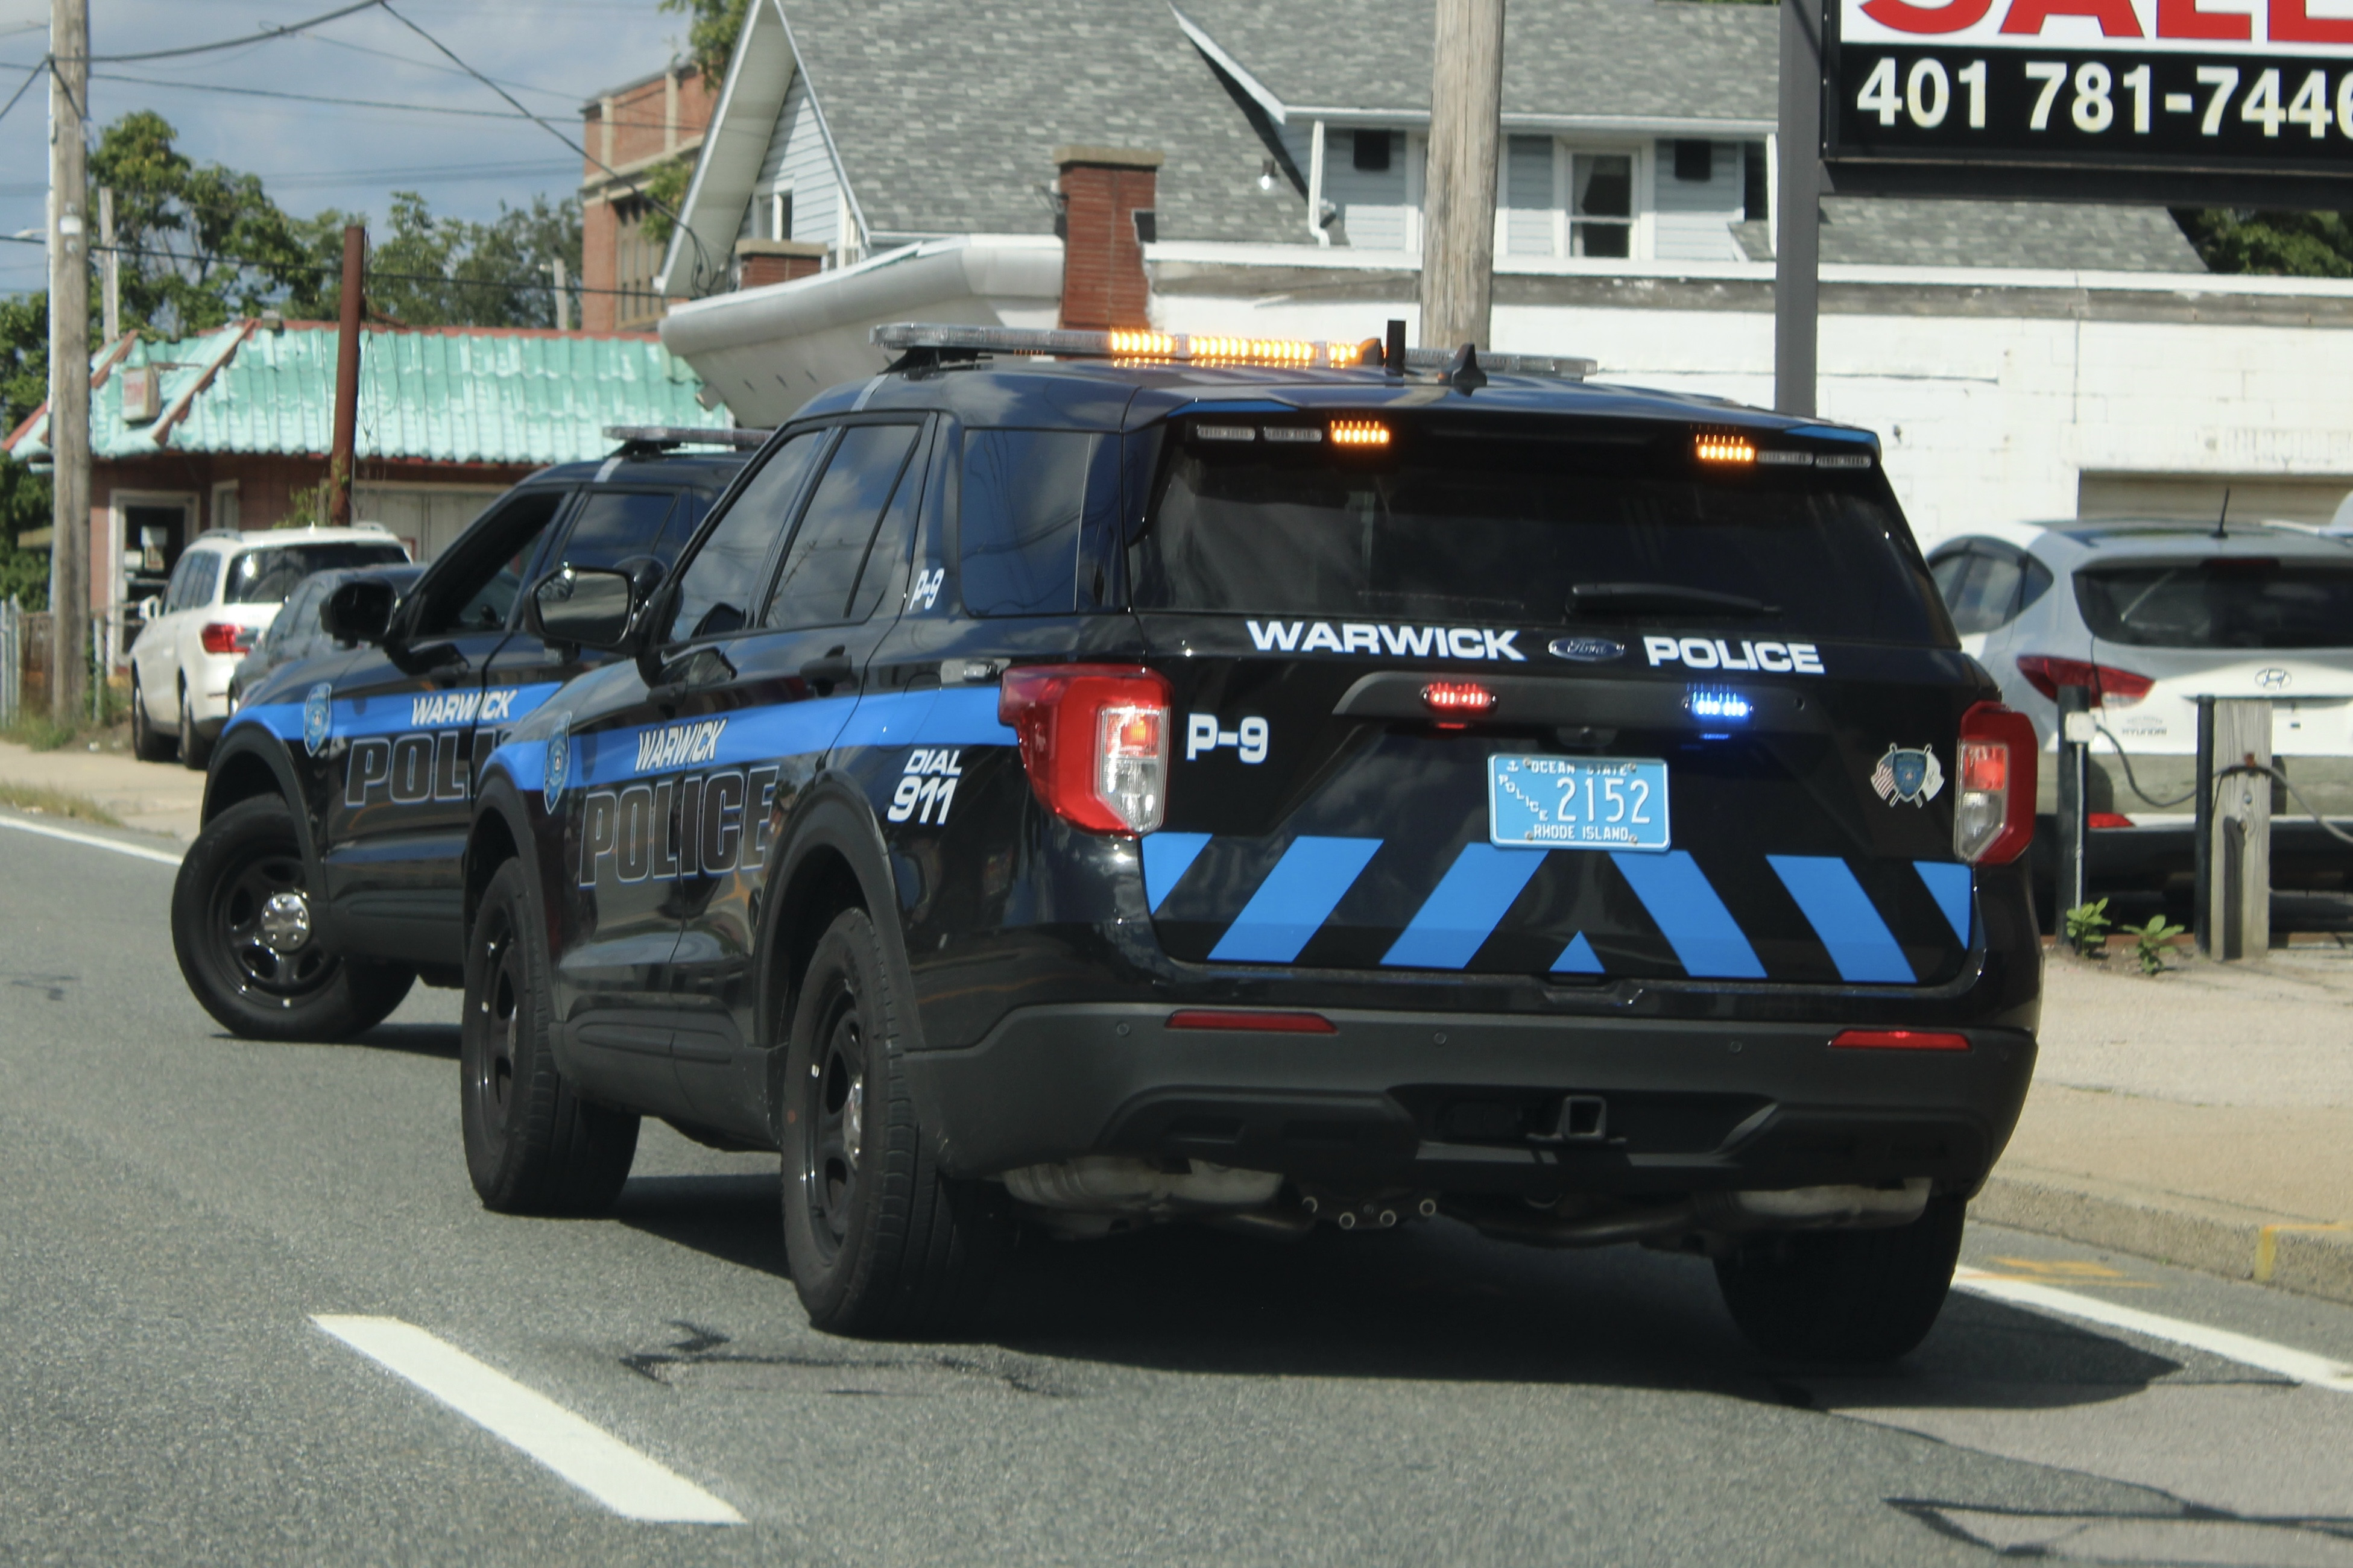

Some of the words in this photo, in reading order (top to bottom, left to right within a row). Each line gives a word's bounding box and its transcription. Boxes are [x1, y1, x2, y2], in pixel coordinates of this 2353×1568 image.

[1857, 57, 1986, 128] 401
[909, 568, 945, 611] P-9
[1246, 620, 1527, 661] WARWICK
[1643, 635, 1825, 674] POLICE
[411, 689, 518, 726] WARWICK
[635, 717, 728, 772] WARWICK
[904, 749, 963, 776] DIAL
[1186, 713, 1269, 764] P-9
[344, 726, 513, 807] POLI
[1530, 760, 1576, 775] OCEAN
[887, 775, 959, 825] 911
[1499, 774, 1549, 822] POLICE
[1556, 776, 1651, 824] 2152
[579, 765, 780, 889] POLICE
[1533, 824, 1576, 839] RHODE
[1582, 825, 1628, 841] ISLAND
